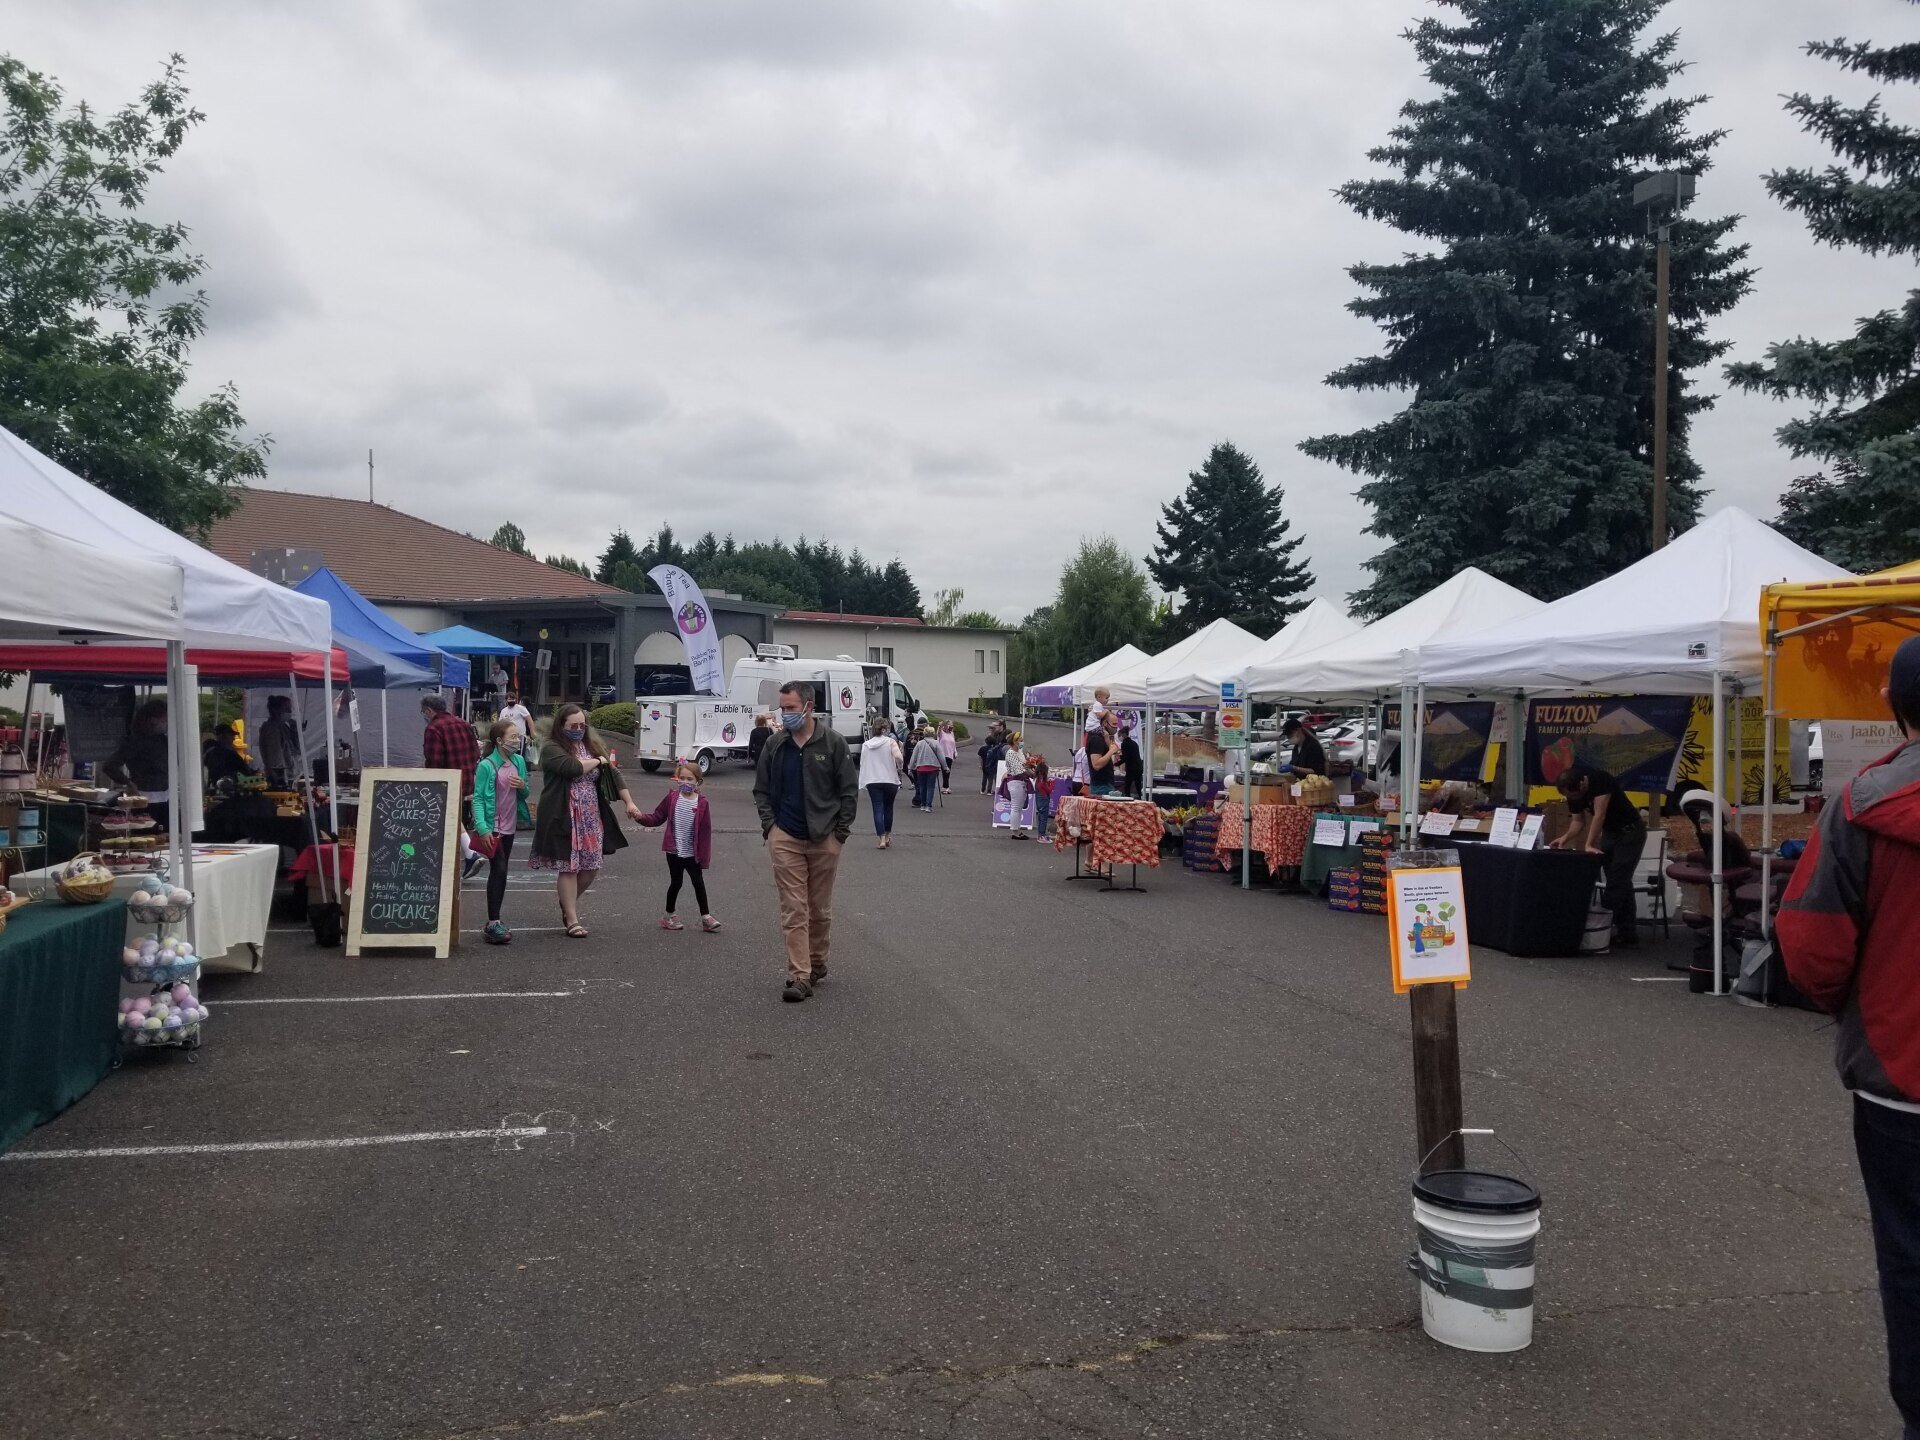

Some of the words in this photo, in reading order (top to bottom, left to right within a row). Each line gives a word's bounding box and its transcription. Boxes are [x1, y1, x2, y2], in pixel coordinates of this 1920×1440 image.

[665, 568, 677, 598] Bubble
[678, 572, 691, 590] Tea
[714, 704, 739, 714] Bubble
[741, 705, 753, 714] Tea
[1535, 704, 1601, 724] FULTON
[1538, 725, 1564, 735] FAMILY
[1566, 725, 1593, 735] FARMS
[1850, 725, 1886, 740] JaaRo
[376, 783, 412, 815] PALEO
[395, 798, 420, 809] CUP
[391, 809, 427, 820] CAKES
[419, 787, 441, 830] GLUTEN
[401, 892, 431, 901] CAKES
[370, 903, 438, 923] CUPCAKES
